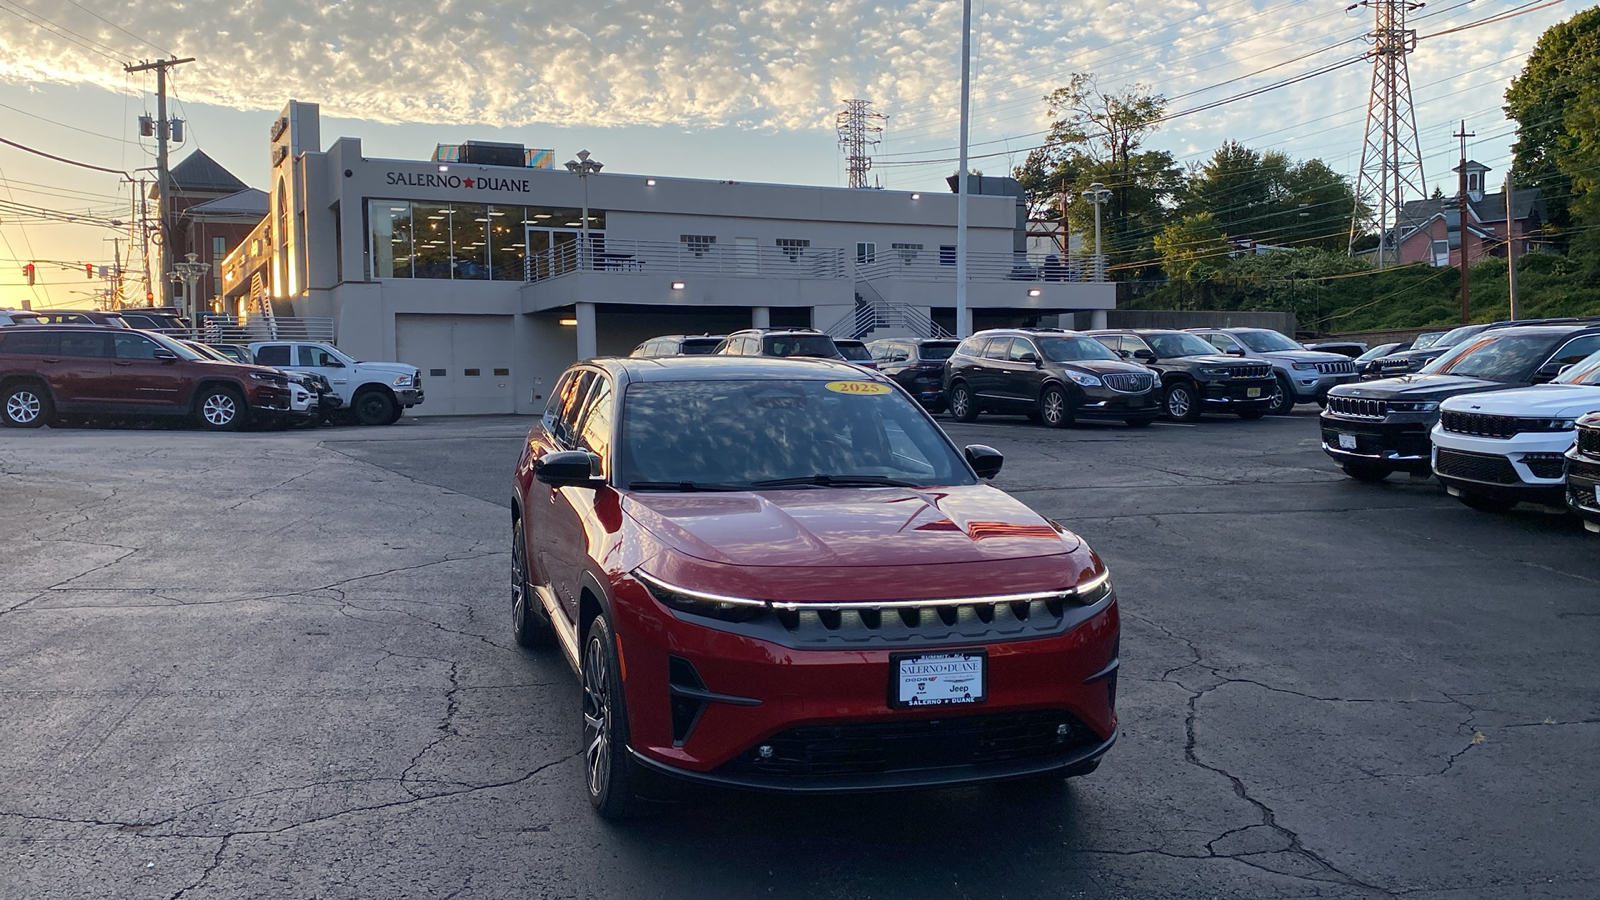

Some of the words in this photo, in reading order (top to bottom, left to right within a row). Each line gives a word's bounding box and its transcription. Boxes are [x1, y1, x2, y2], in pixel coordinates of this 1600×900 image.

[386, 171, 461, 189] SALERNO
[477, 177, 531, 193] DUANE
[839, 383, 880, 392] 2025
[901, 664, 943, 675] SALERNO
[947, 662, 979, 672] DUANE
[949, 685, 969, 693] Jeep
[908, 698, 942, 706] SALERNO
[952, 696, 975, 704] DUANE
